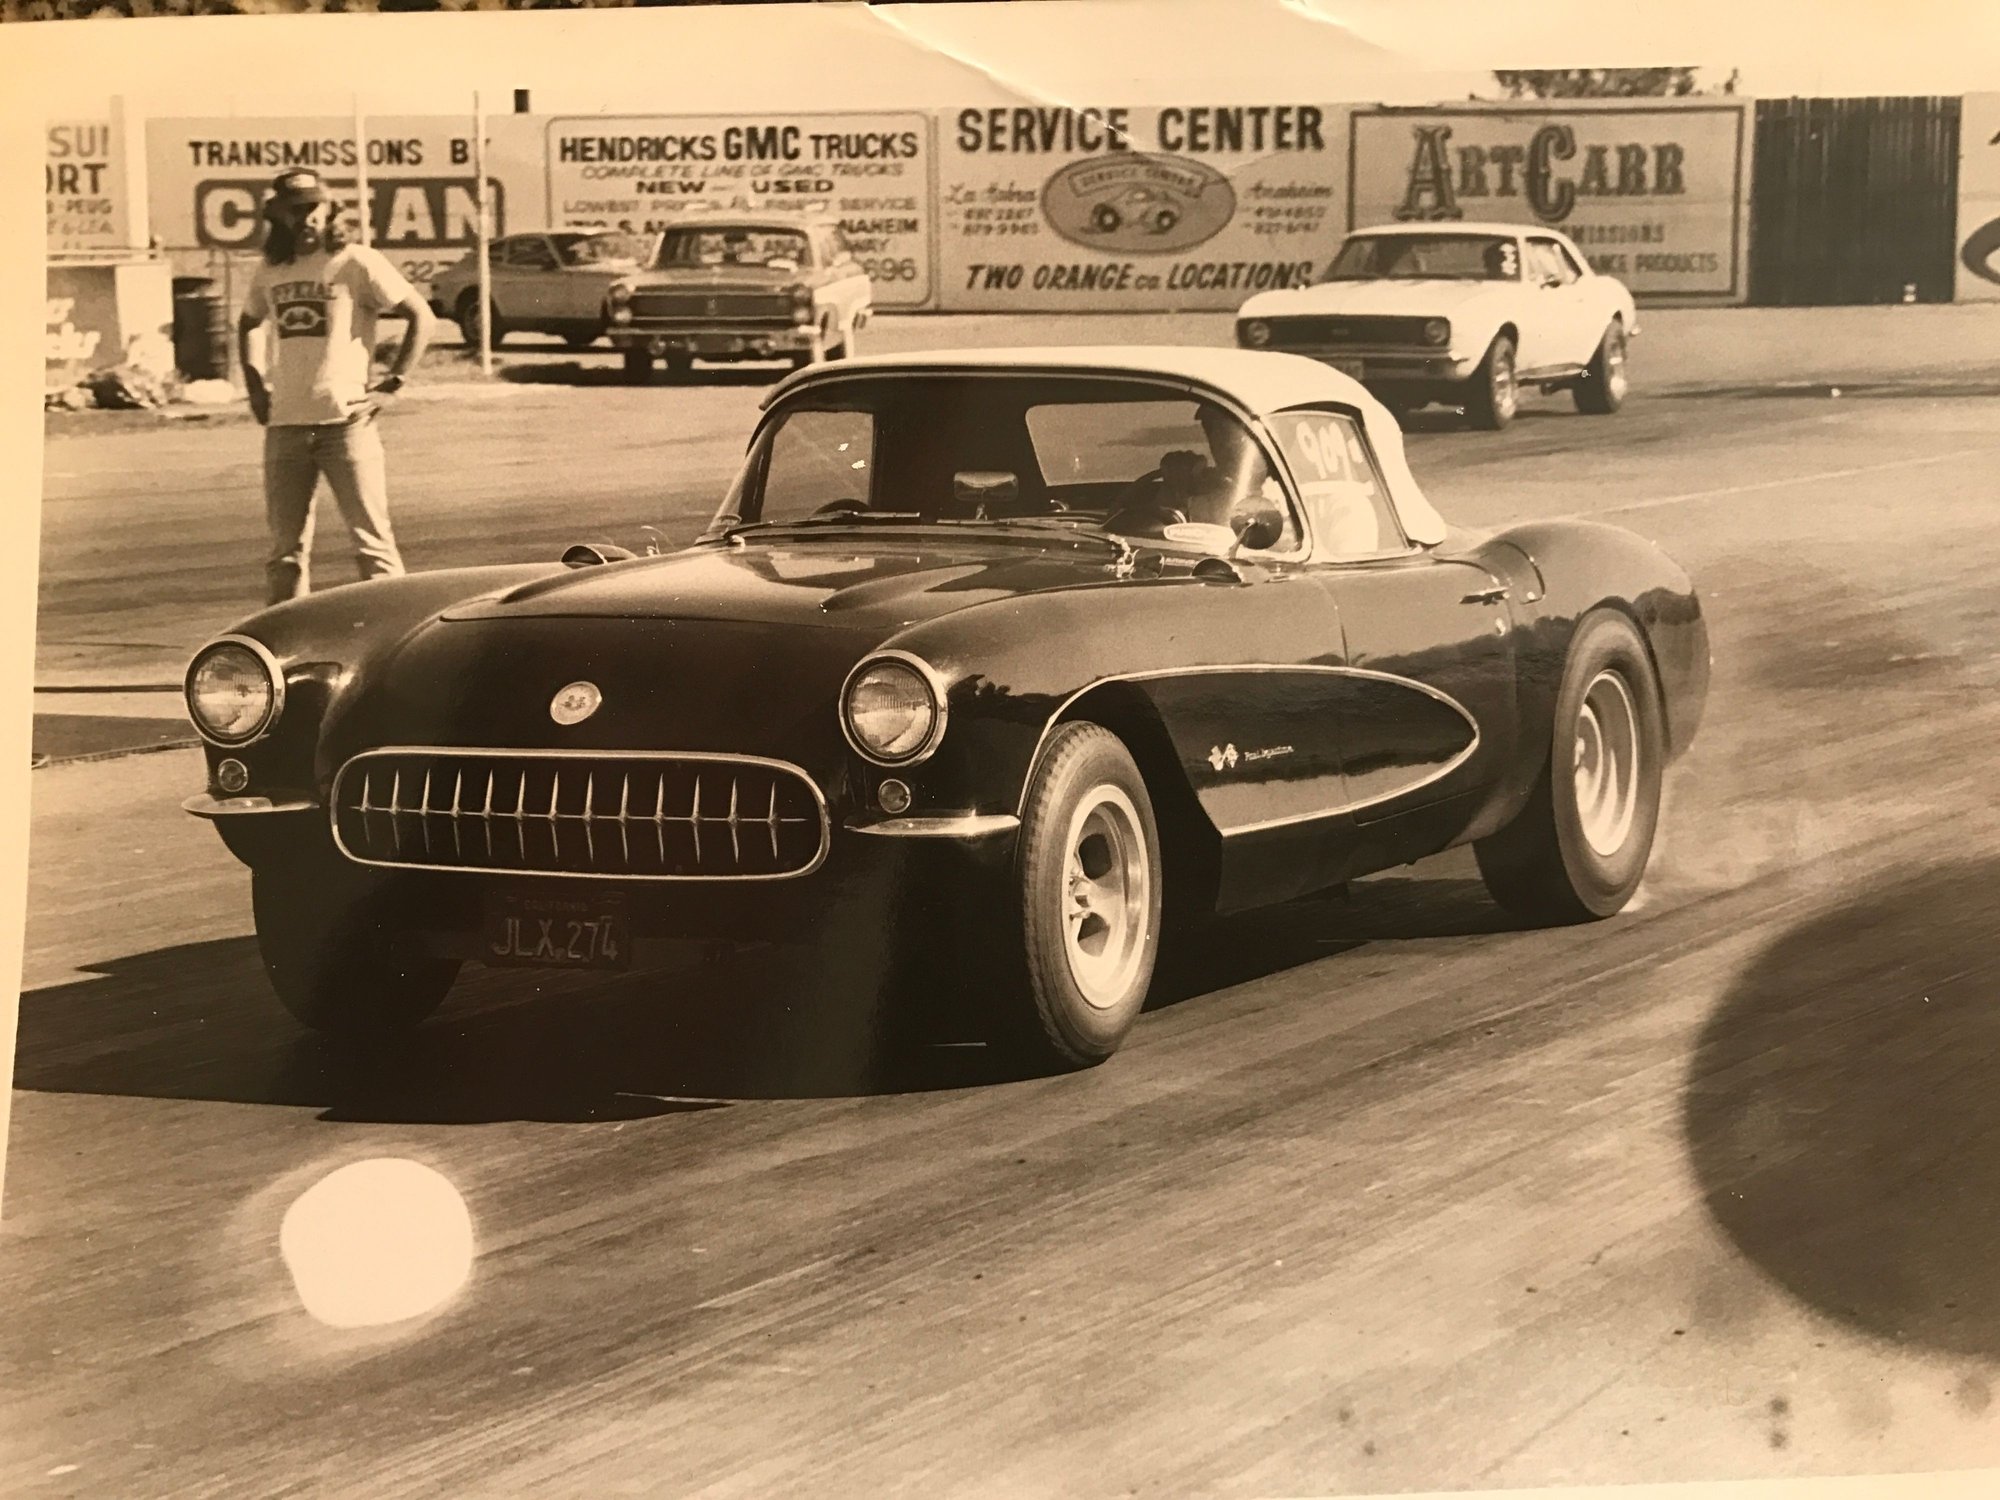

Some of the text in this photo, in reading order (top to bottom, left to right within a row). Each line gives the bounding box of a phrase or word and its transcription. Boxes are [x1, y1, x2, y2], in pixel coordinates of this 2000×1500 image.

[560, 126, 918, 162] HENDRICKS GMC TRUCKS
[955, 106, 1325, 152] SERVICE CENTER
[188, 139, 423, 167] TRANSMISSONS
[635, 180, 705, 194] NEW
[752, 179, 834, 194] USED
[204, 187, 497, 240] CEAN
[837, 217, 918, 234] NAHEIM
[965, 264, 1024, 290] TWO
[1033, 264, 1131, 290] ORANGE
[1166, 261, 1315, 290] LOCATIONS
[491, 914, 618, 960] JLX 274
